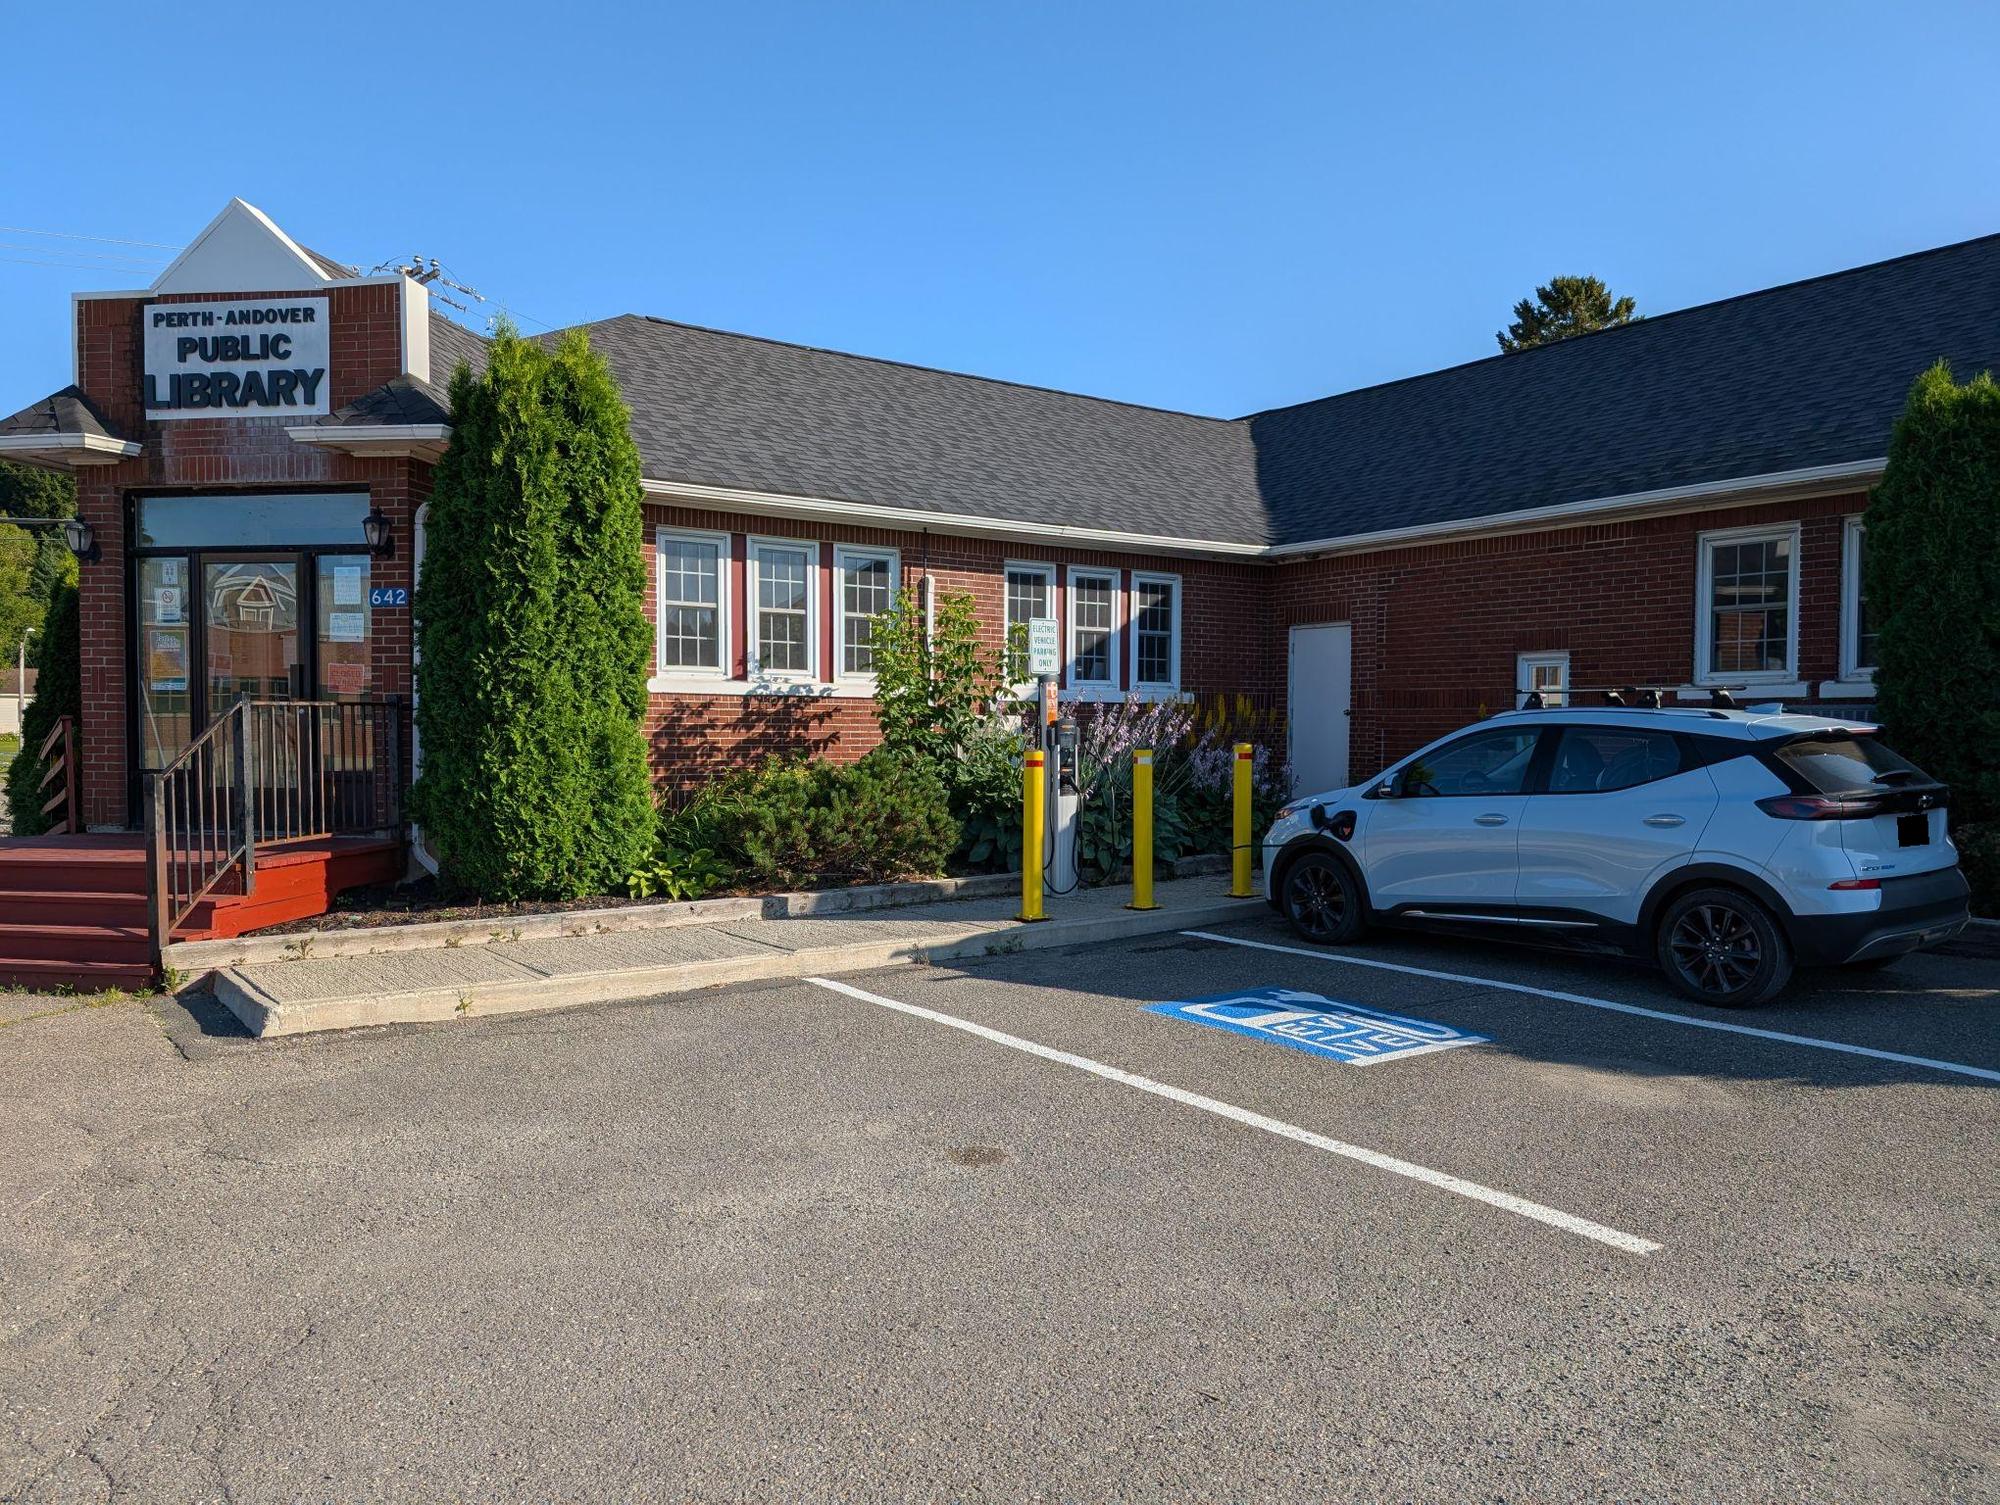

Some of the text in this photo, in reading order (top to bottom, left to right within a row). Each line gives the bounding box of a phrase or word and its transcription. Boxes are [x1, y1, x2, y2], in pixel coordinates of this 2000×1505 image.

[177, 333, 292, 363] PUBLIC
[144, 368, 325, 410] LIBRARY
[371, 589, 406, 605] 642
[1032, 624, 1056, 634] ELECTRIC
[1033, 636, 1055, 645] VEHICLE
[1033, 647, 1057, 656] PARKING
[1038, 659, 1053, 667] ONLY
